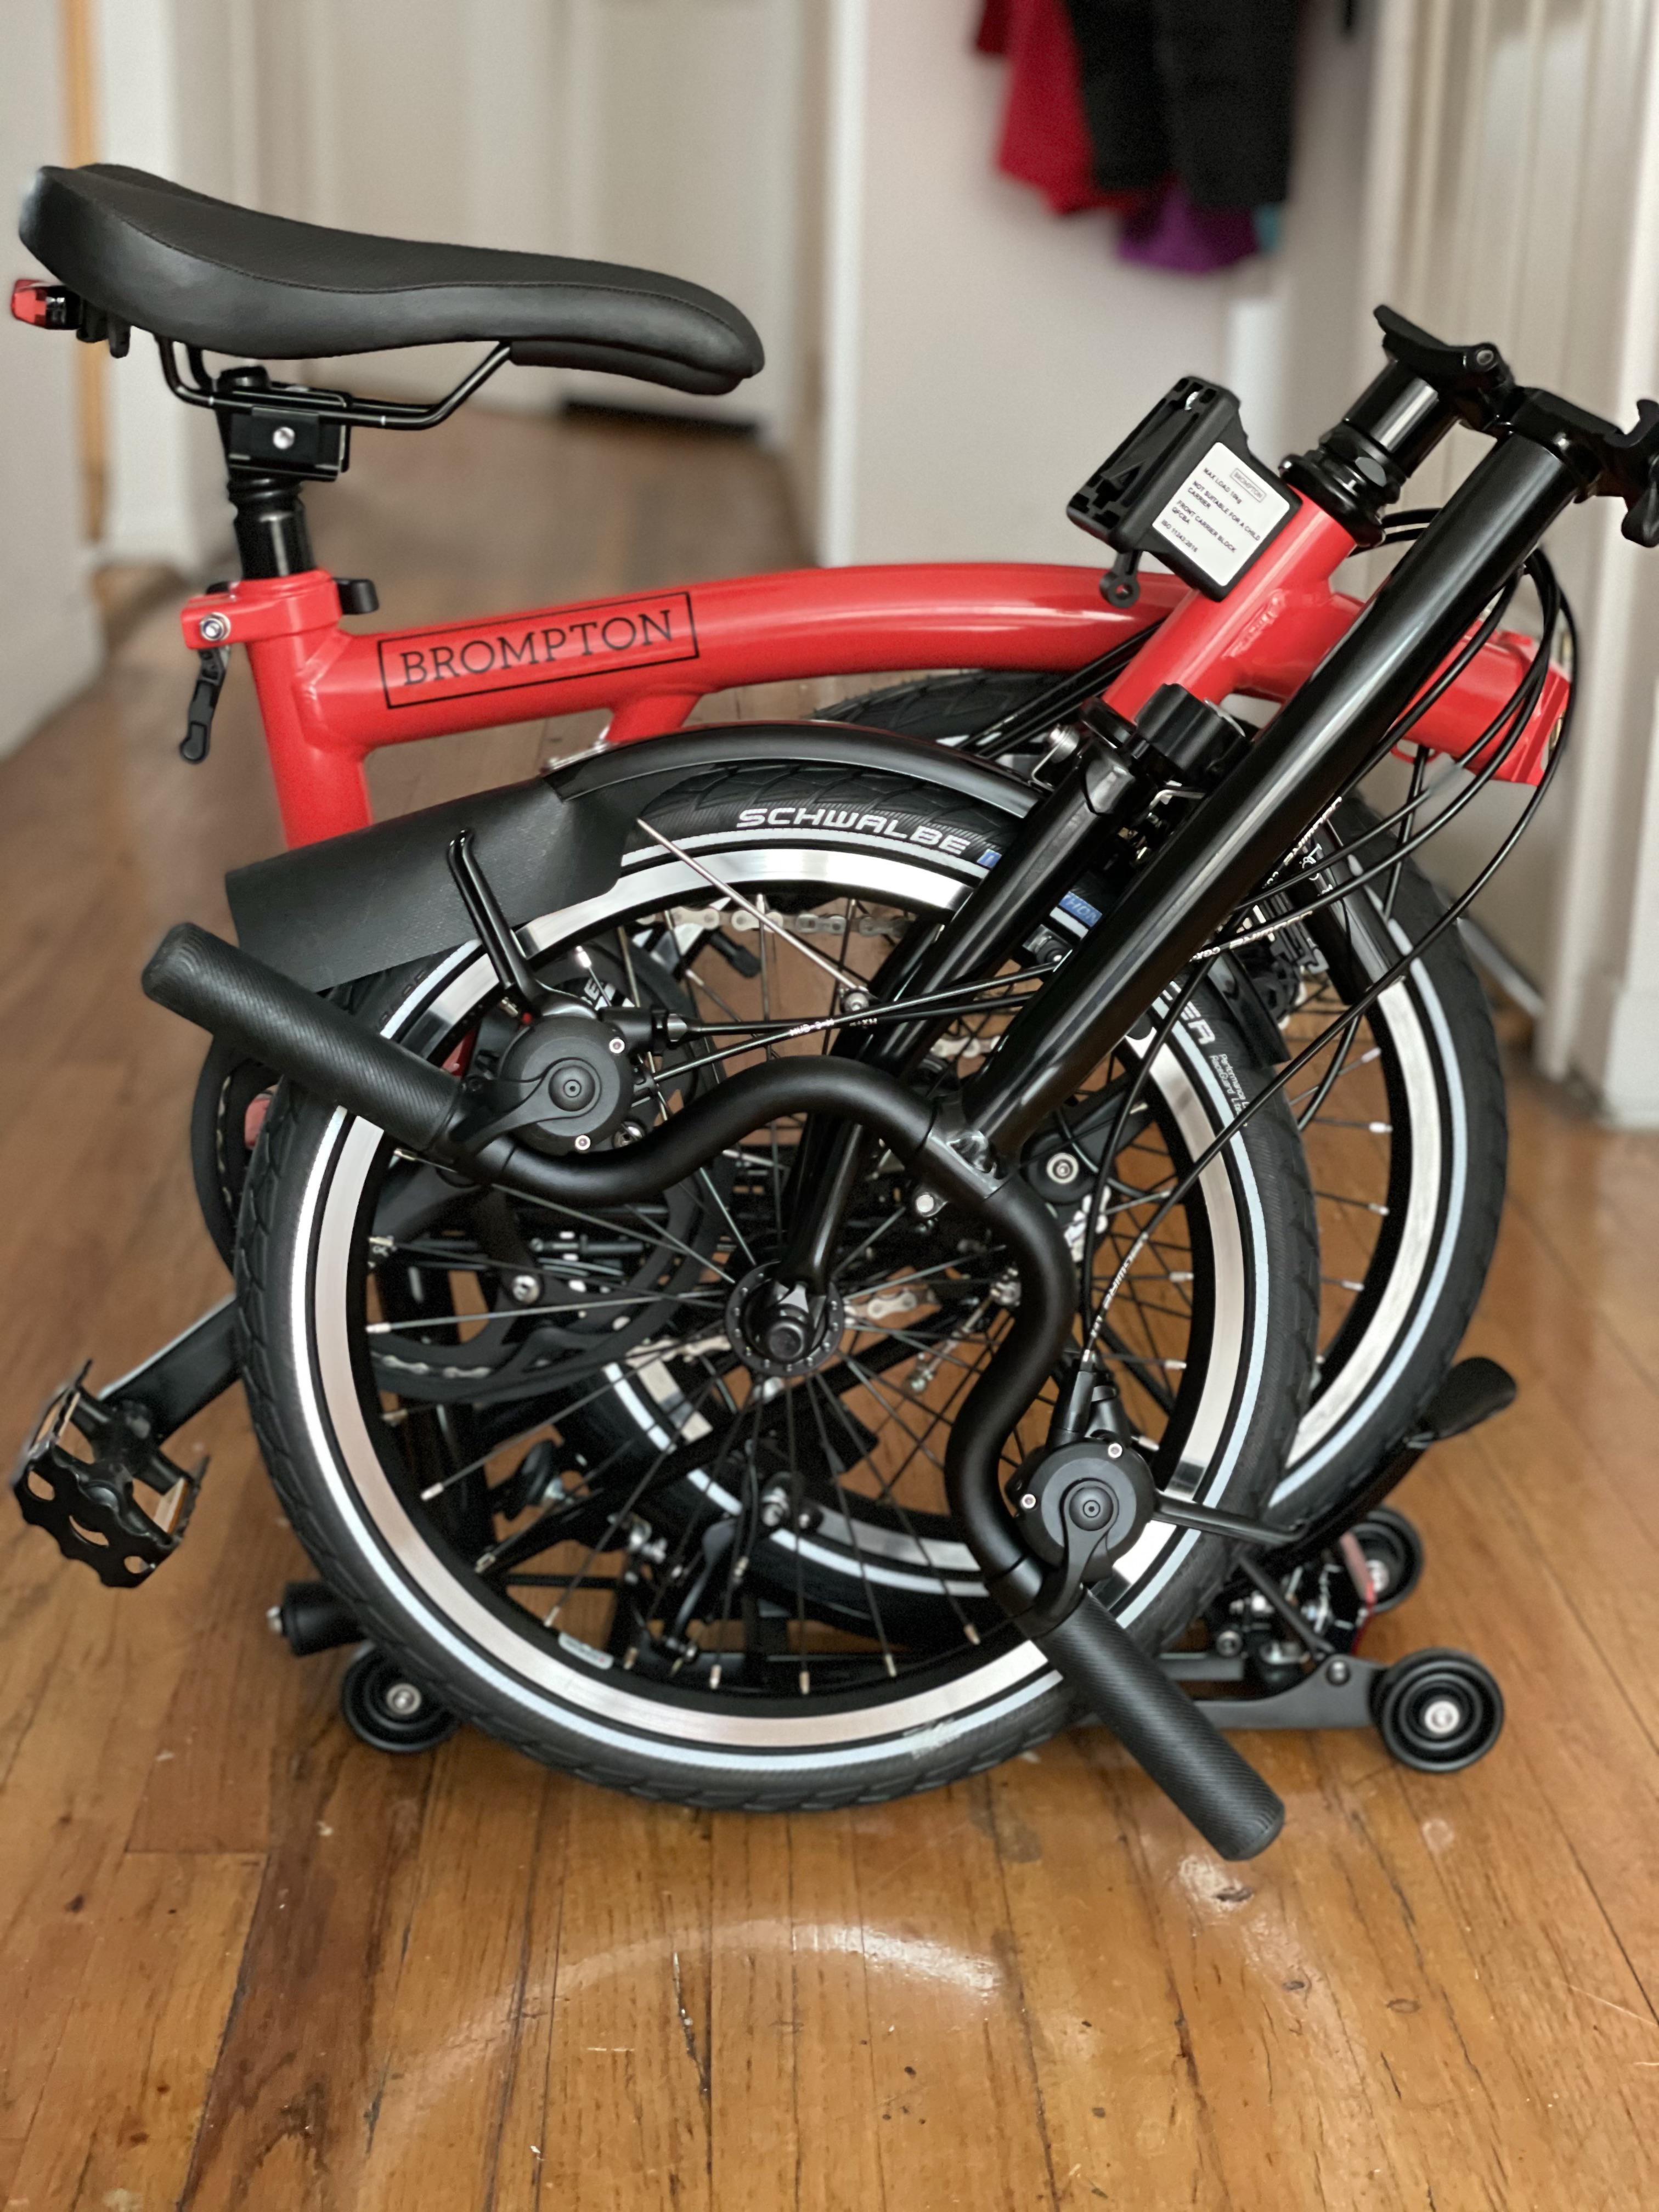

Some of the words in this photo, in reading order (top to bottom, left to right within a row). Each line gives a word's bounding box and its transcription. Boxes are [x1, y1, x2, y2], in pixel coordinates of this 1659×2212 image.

[1188, 487, 1211, 508] CARRIER
[1203, 467, 1215, 479] MAX
[1215, 478, 1230, 492] LOAD
[1161, 519, 1171, 529] ISO
[1177, 500, 1195, 517] FRONT
[1194, 515, 1218, 537] CARRIER
[1217, 535, 1236, 552] BLOCK
[1193, 481, 1204, 492] NOT
[1204, 490, 1229, 513] SUITABLE
[1228, 511, 1240, 522] FOR
[1244, 526, 1260, 540] CHILD
[400, 610, 673, 685] BROMPTON
[737, 808, 971, 854] SCHWALBE
[1209, 1055, 1235, 1094] RaceGuard
